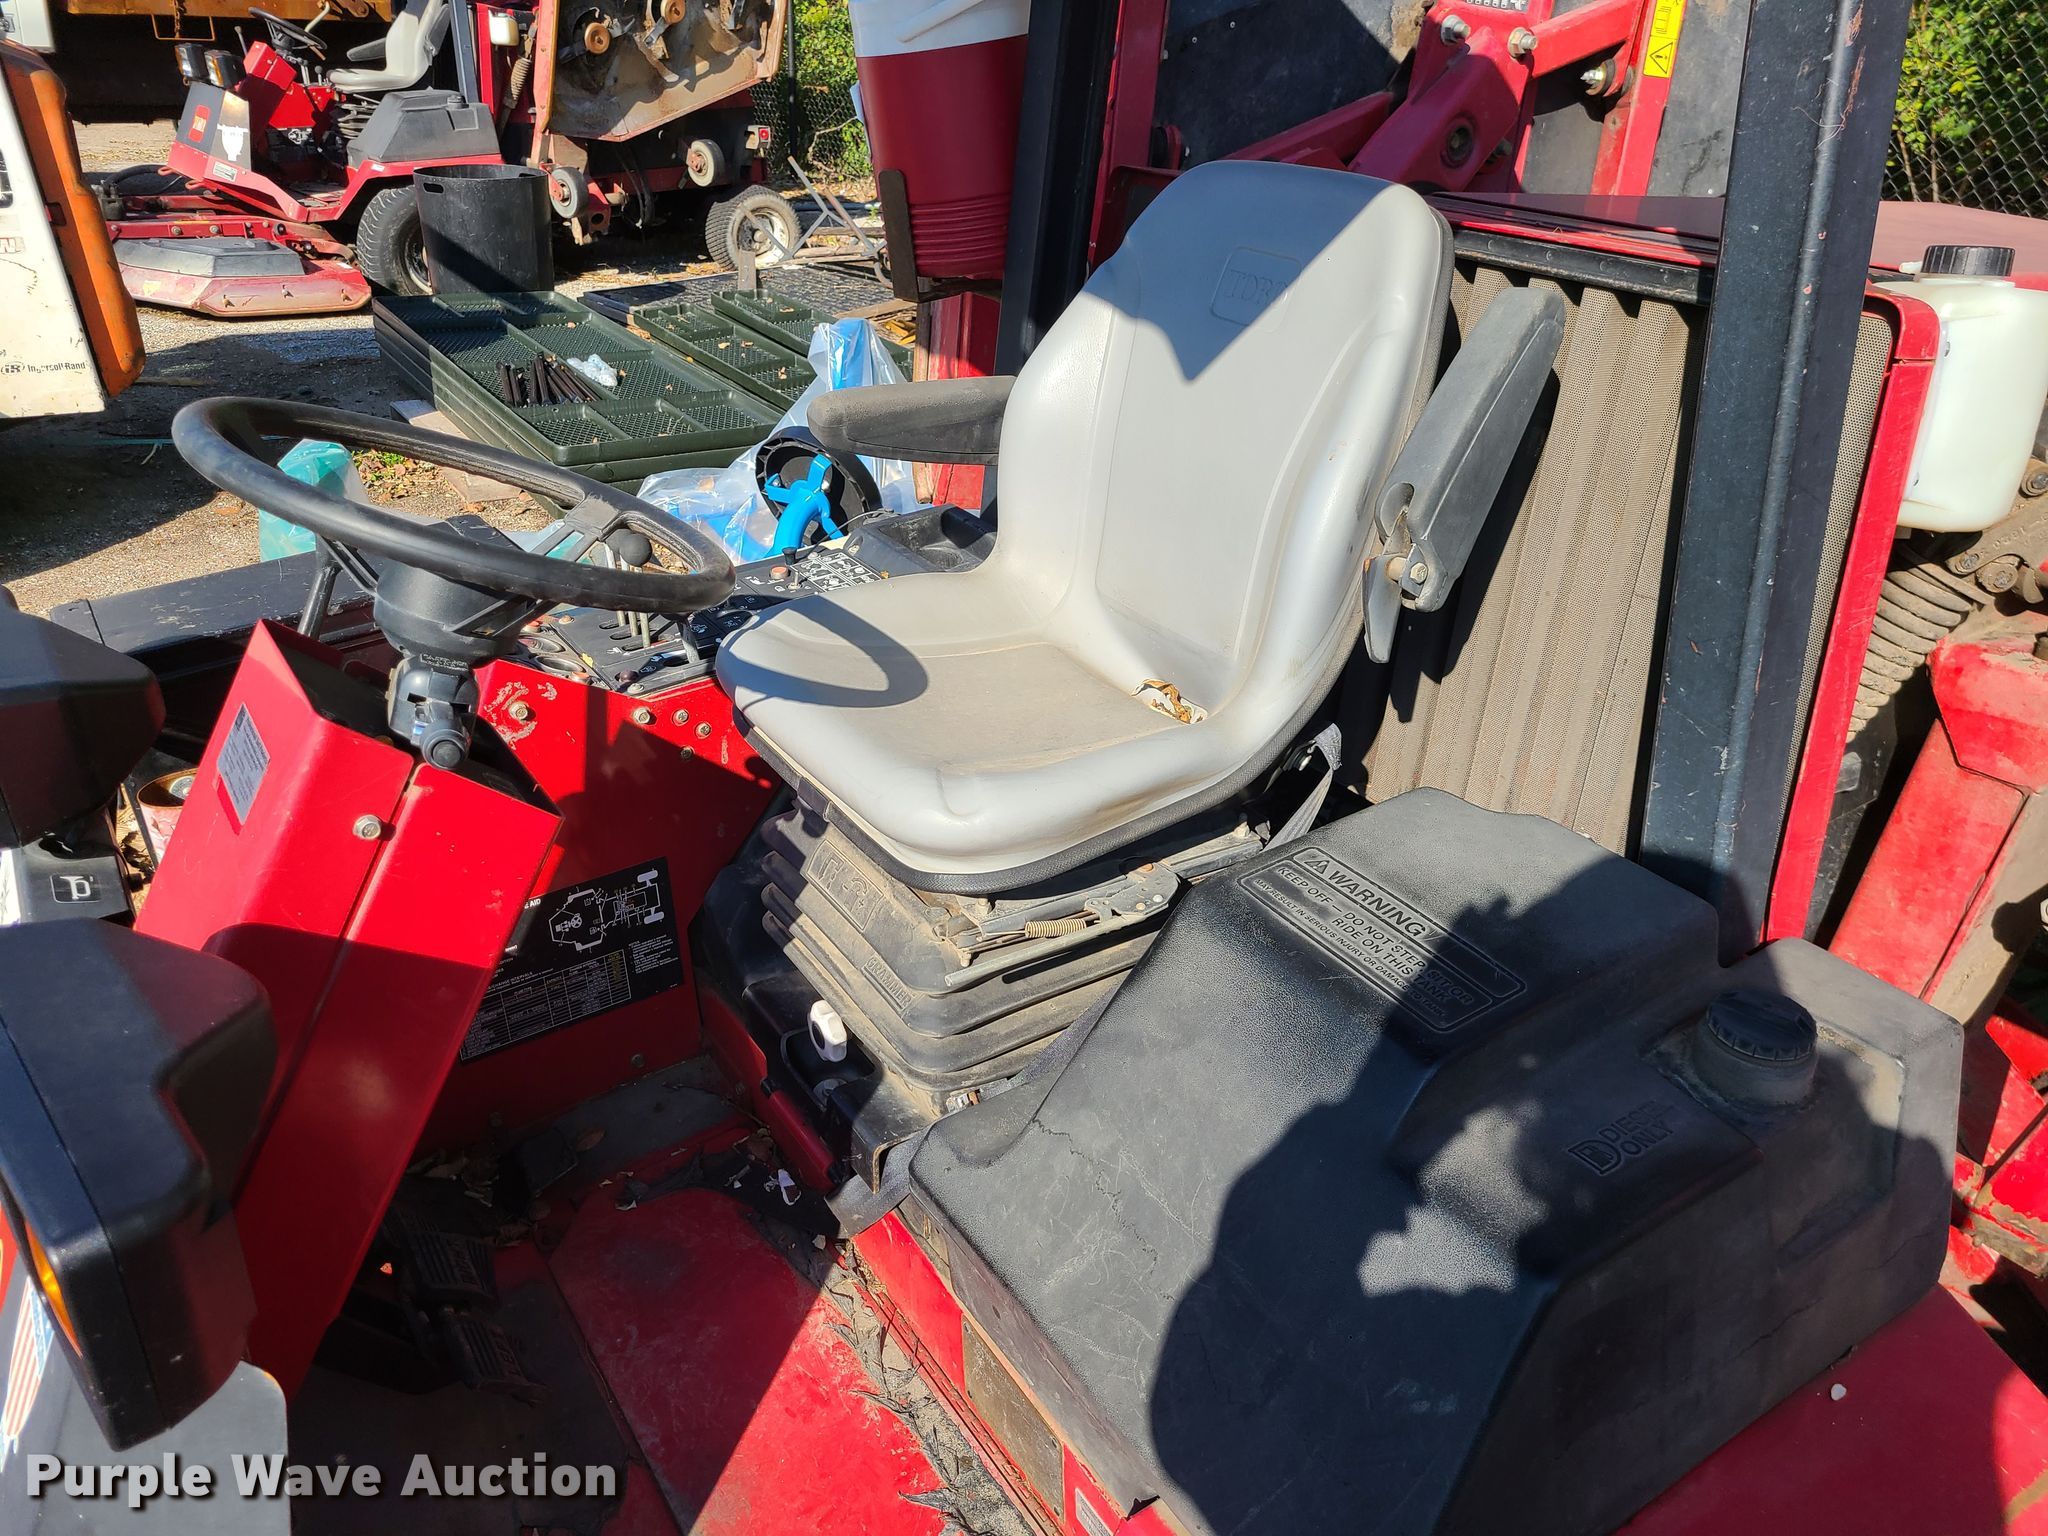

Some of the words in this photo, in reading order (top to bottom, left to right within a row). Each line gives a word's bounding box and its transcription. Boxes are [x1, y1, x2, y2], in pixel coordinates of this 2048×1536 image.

[1253, 879, 1273, 893] MAY
[1268, 890, 1299, 911] RESULT
[1295, 908, 1306, 917] IN
[1303, 914, 1337, 939] SERIOUS
[1335, 936, 1364, 958] INJURY
[1362, 956, 1376, 967] OR
[1374, 965, 1410, 991] DAMAGE
[1278, 867, 1309, 890] KEEP
[1307, 887, 1334, 905] OFF
[1342, 911, 1366, 928] DO
[1361, 924, 1393, 946] NOT
[1427, 971, 1452, 989] SIT
[1449, 986, 1474, 1004] OR
[1328, 869, 1428, 939] WARNING
[866, 957, 912, 1007] GRAMMER
[1331, 918, 1362, 940] RIDE
[1362, 938, 1384, 955] ON
[1382, 952, 1414, 977] THIS
[1413, 975, 1451, 1002] TANK
[1599, 1100, 1675, 1141] DIESEL
[1621, 1122, 1675, 1156] ONLY
